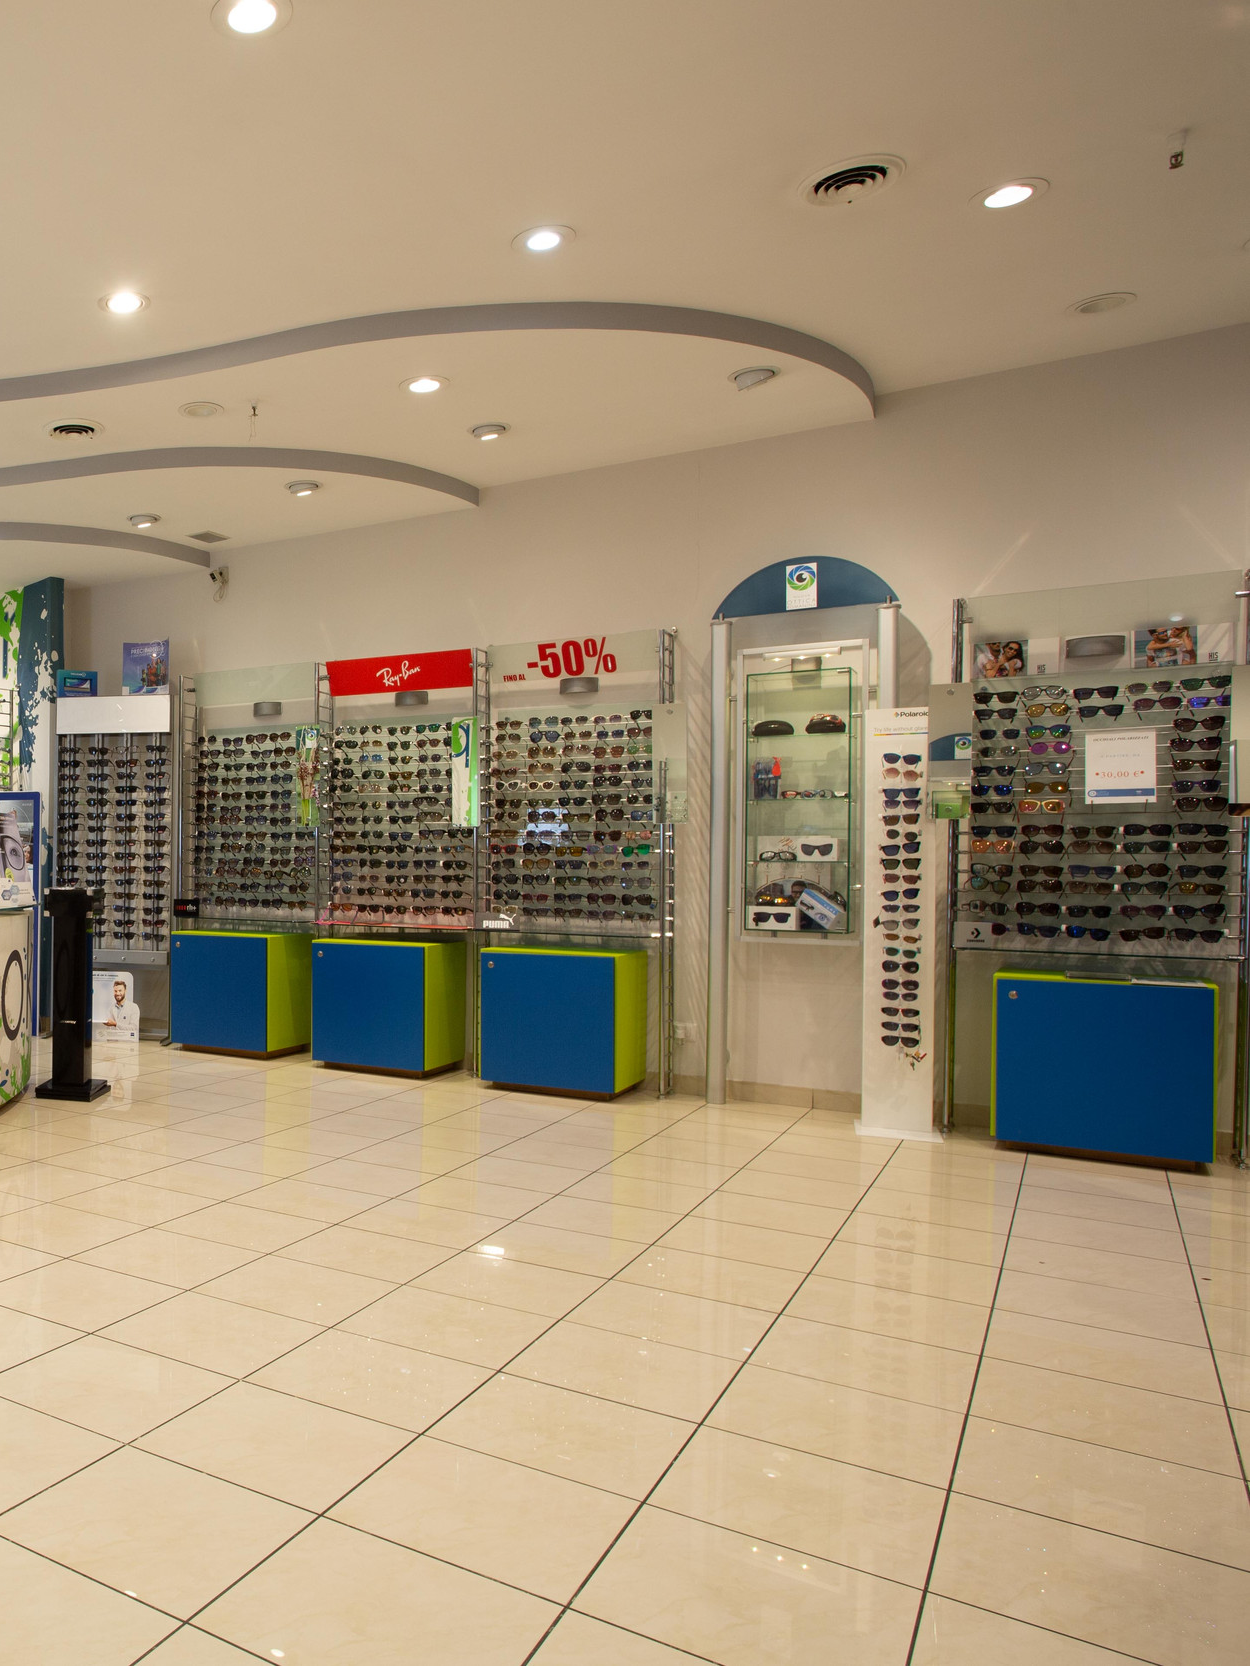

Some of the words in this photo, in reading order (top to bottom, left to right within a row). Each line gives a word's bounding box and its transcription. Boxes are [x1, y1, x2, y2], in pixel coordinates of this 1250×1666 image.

[527, 637, 617, 679] -50%
[376, 660, 421, 687] Ray-Ban
[483, 920, 510, 928] PUMA
